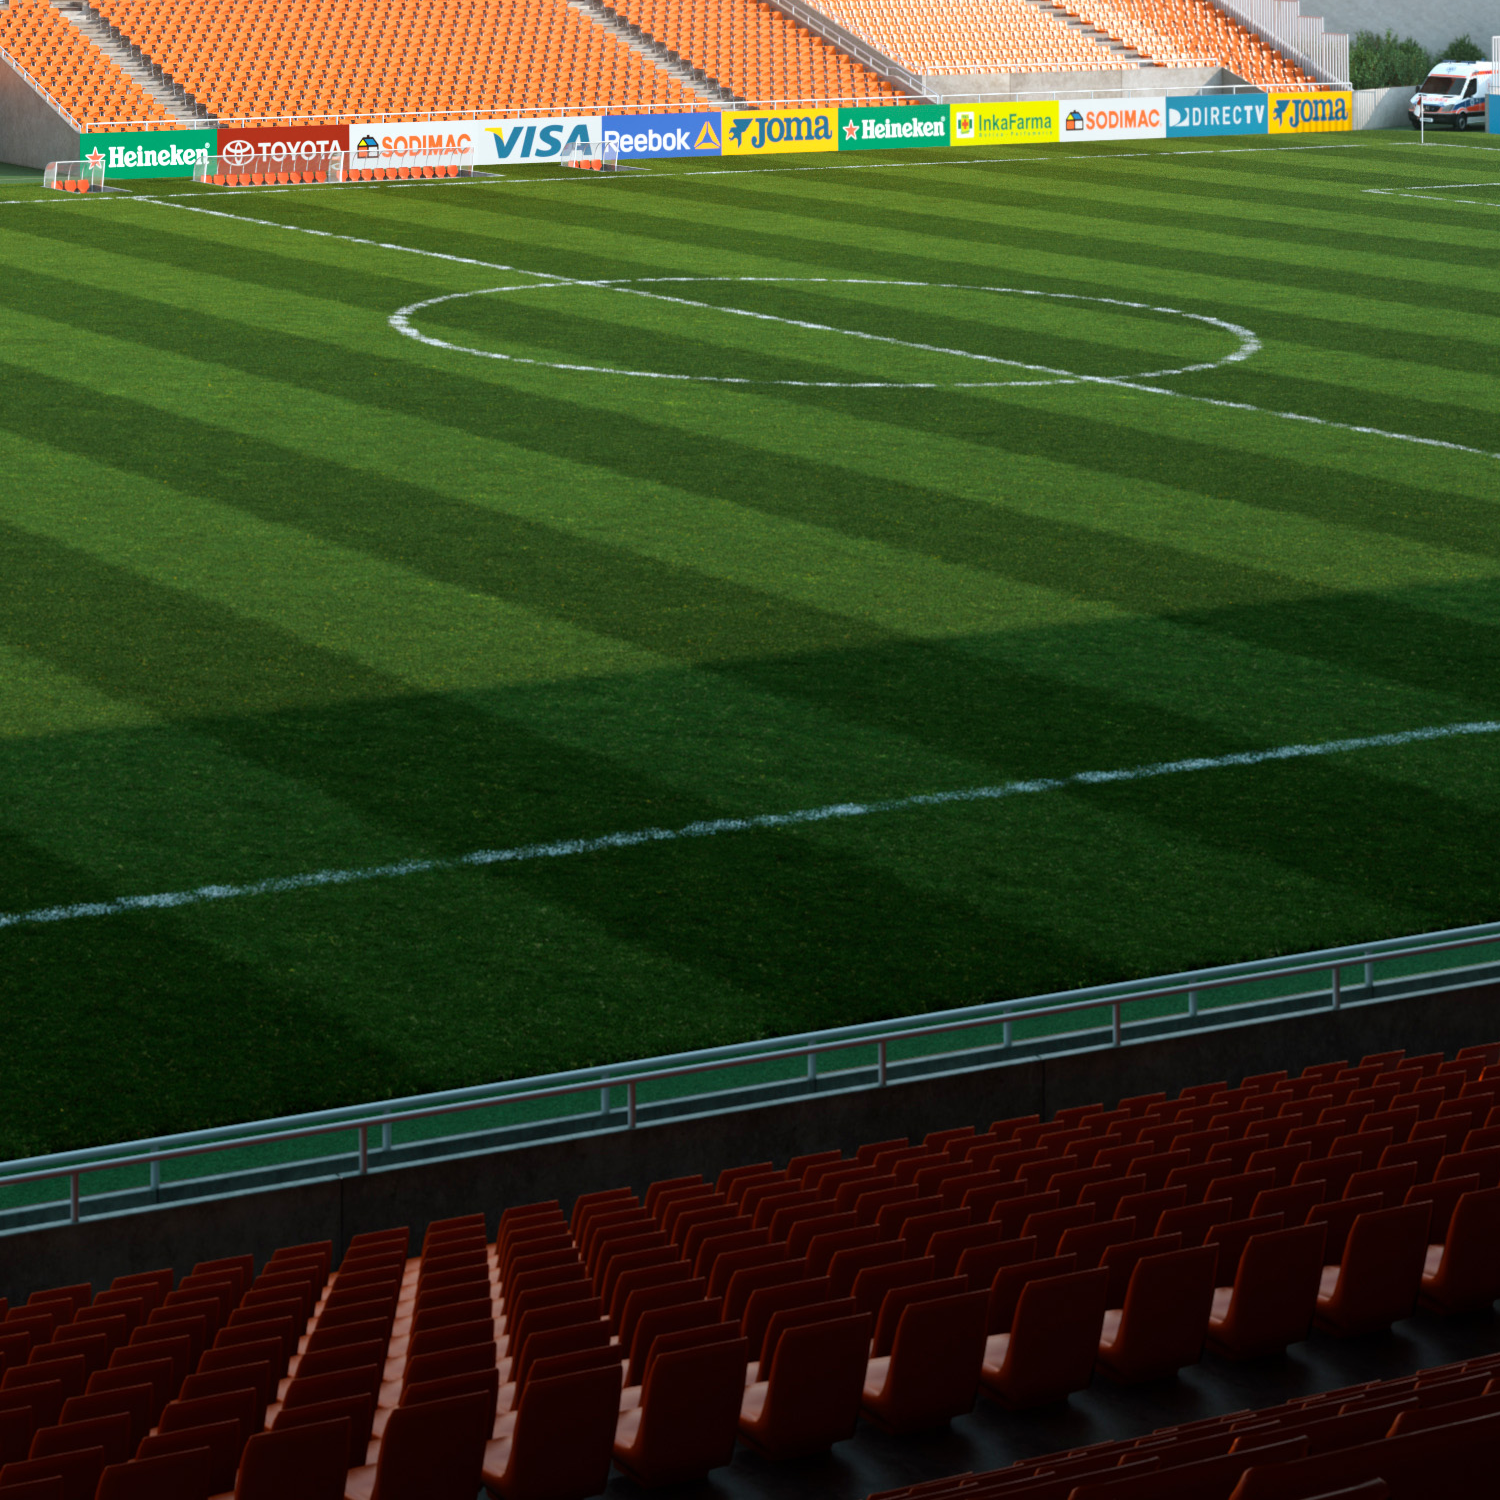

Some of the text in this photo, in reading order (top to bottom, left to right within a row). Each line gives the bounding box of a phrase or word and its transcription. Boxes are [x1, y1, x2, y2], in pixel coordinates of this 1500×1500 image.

[978, 113, 1052, 131] InkaFarma
[1086, 109, 1160, 130] SODIMAC
[1192, 104, 1265, 126] DIRECTV
[1288, 97, 1349, 128] Joma
[604, 128, 691, 153] Reebok
[752, 115, 833, 149] Joma
[861, 118, 945, 140] Heineken
[257, 140, 342, 161] TOYOTA
[381, 133, 472, 158] SODIMAC
[485, 124, 592, 159] VISA
[108, 144, 208, 168] Heineken
